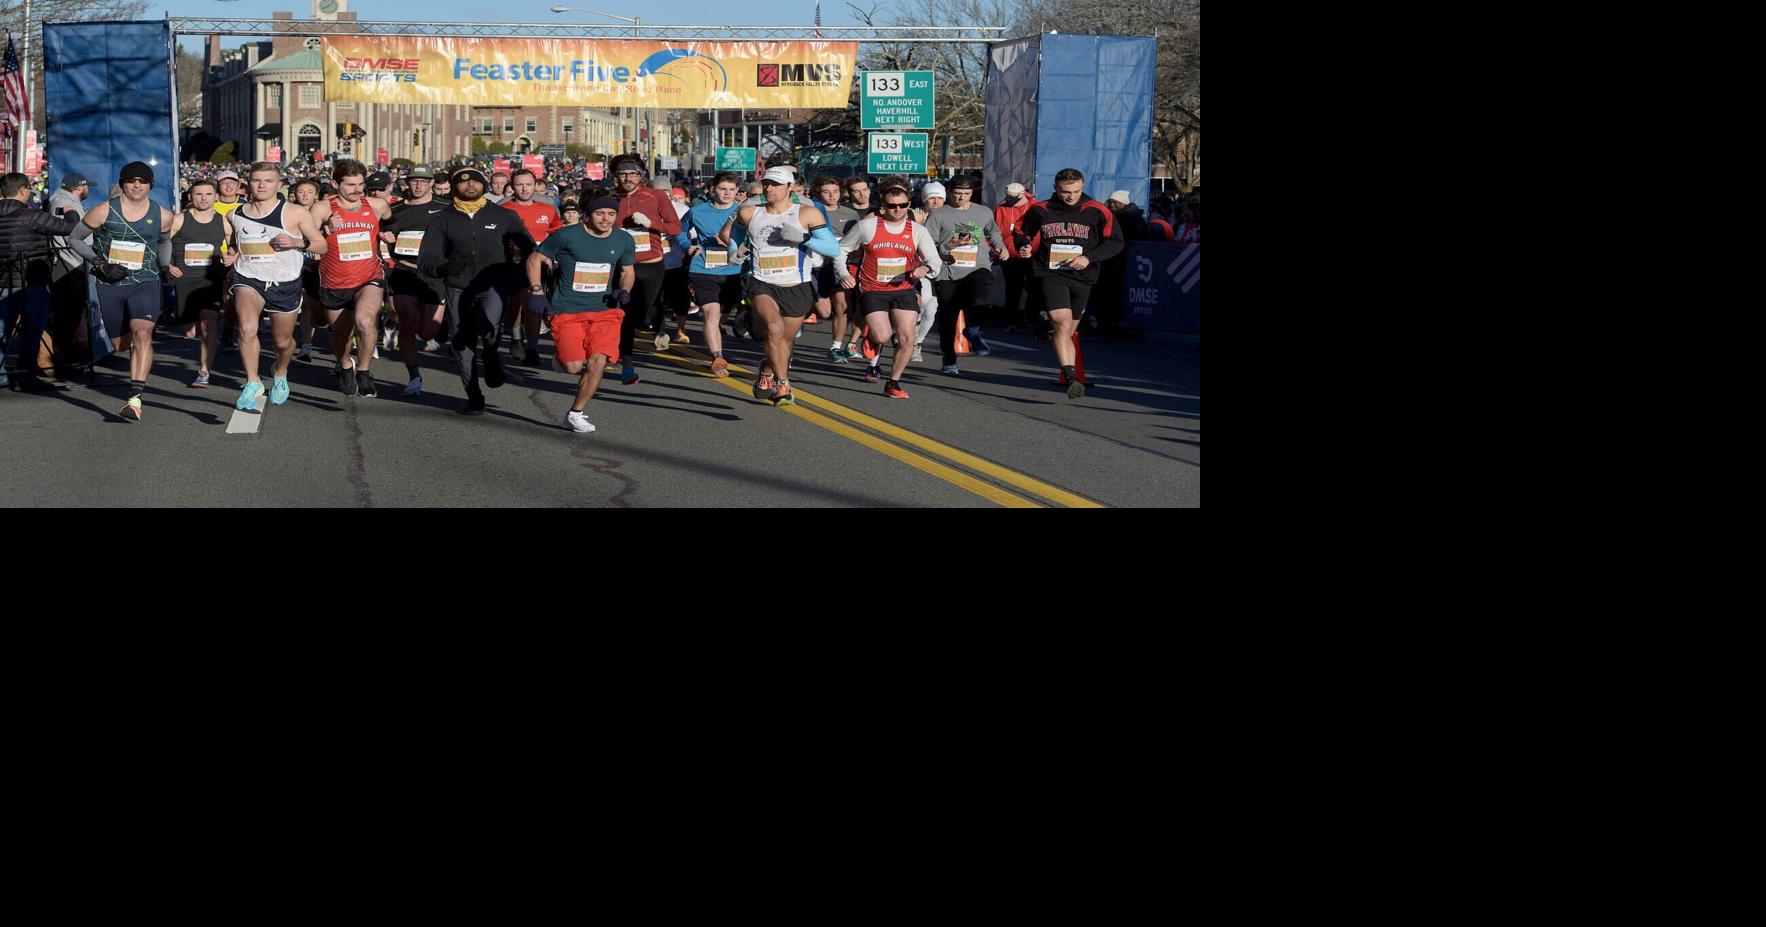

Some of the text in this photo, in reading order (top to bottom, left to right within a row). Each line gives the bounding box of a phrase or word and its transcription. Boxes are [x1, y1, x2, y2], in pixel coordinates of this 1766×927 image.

[453, 58, 631, 82] Feaster Five
[781, 63, 842, 82] MVS
[871, 78, 928, 91] 133 EAST
[876, 107, 919, 115] HAVERHILL
[876, 139, 925, 149] 133 WEST
[882, 154, 912, 162] LOWELL
[873, 241, 912, 252] WHIRLAWAY
[1129, 287, 1159, 305] DMSE
